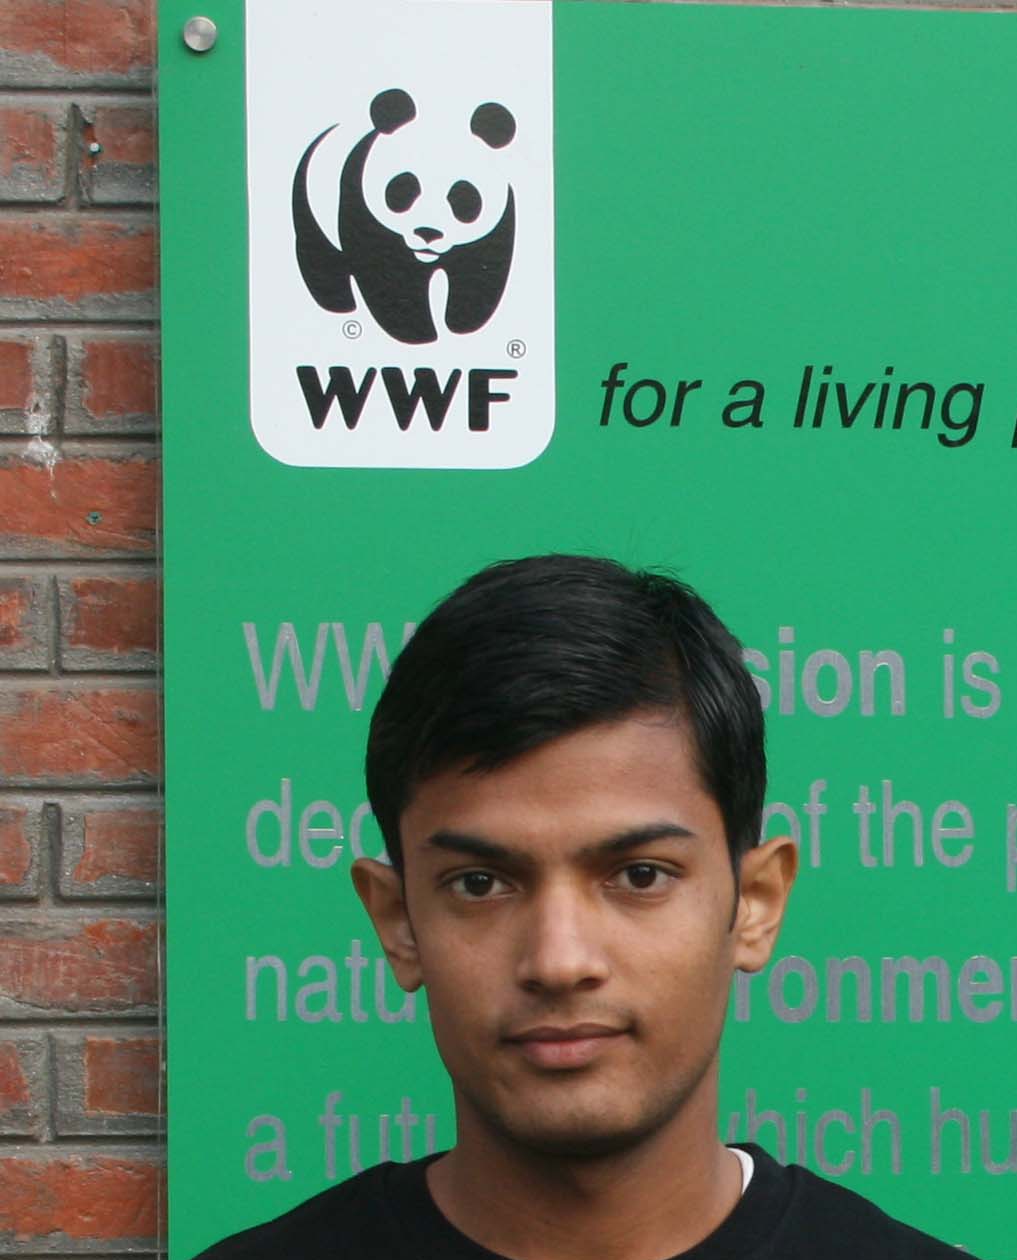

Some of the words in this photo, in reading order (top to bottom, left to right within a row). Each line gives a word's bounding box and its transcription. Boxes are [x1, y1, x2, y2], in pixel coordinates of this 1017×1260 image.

[296, 365, 518, 432] WWF
[599, 362, 703, 428] for
[721, 379, 765, 428] a
[793, 365, 985, 449] living
[242, 621, 417, 713] WW
[742, 627, 907, 718] sion
[943, 629, 1001, 719] is
[852, 780, 974, 868] the
[245, 940, 417, 1023] natu
[244, 1114, 291, 1182] a
[727, 1087, 902, 1175] hich
